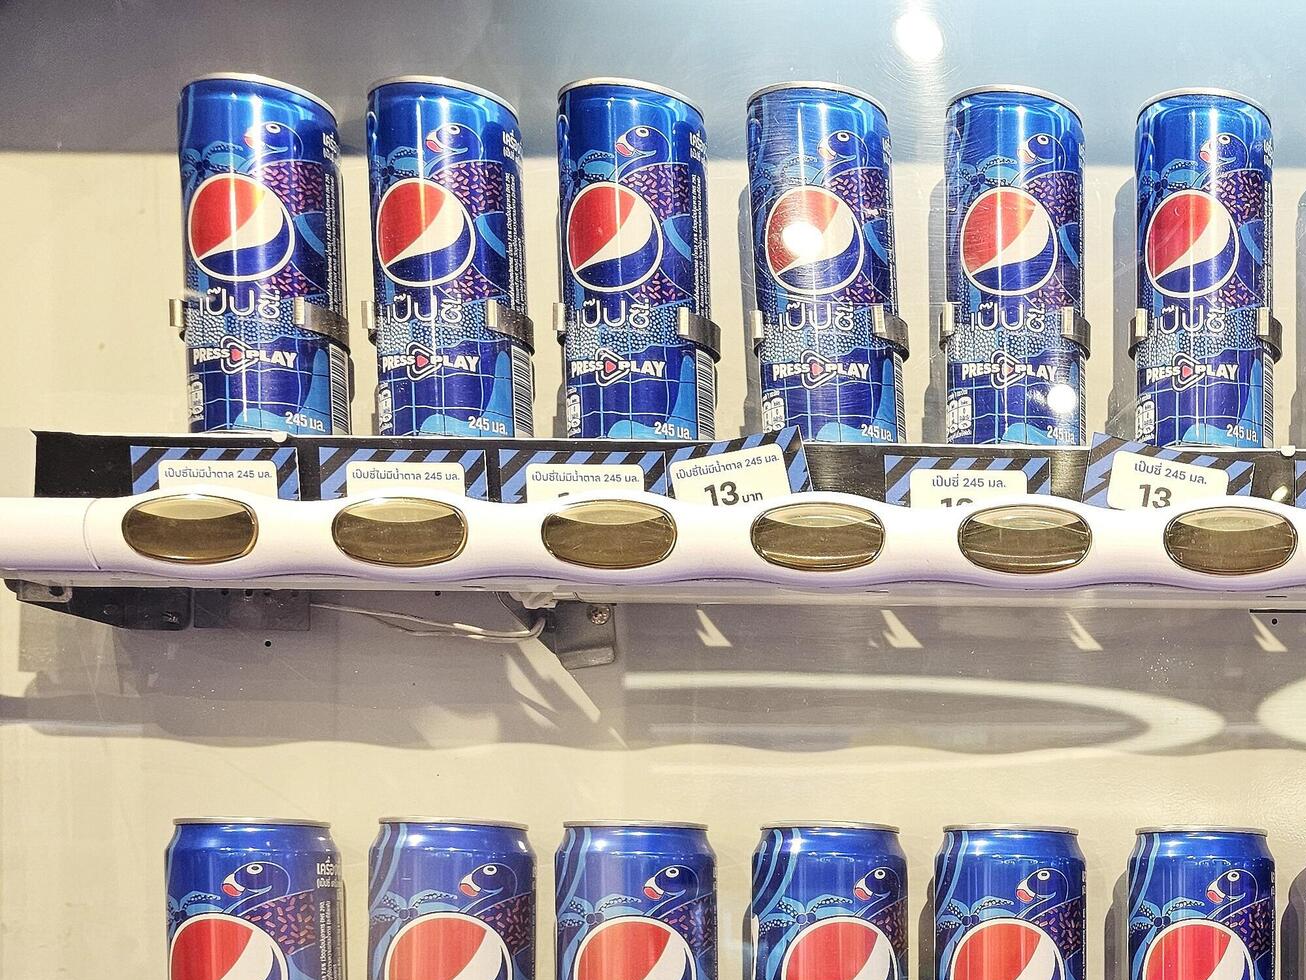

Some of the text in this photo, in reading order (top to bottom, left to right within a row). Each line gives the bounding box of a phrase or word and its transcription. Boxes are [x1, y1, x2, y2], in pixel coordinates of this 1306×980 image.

[199, 287, 280, 319] เป๊ปซี่
[386, 293, 463, 323] เป๊ปซี่
[575, 298, 650, 329] เป๊ปซี่
[969, 302, 1045, 332] เป๊ปซี่
[193, 348, 298, 368] PRESS PLAY
[571, 360, 665, 377] PRESS PLAY
[1146, 364, 1238, 384] PRESS PLAY
[285, 412, 308, 427] 245
[468, 416, 490, 431] 245
[1226, 425, 1244, 439] 245
[745, 459, 762, 470] 245
[1164, 466, 1186, 481] 245
[424, 472, 442, 480] 245
[704, 481, 763, 507] 13 บาท
[1138, 483, 1172, 508] 13
